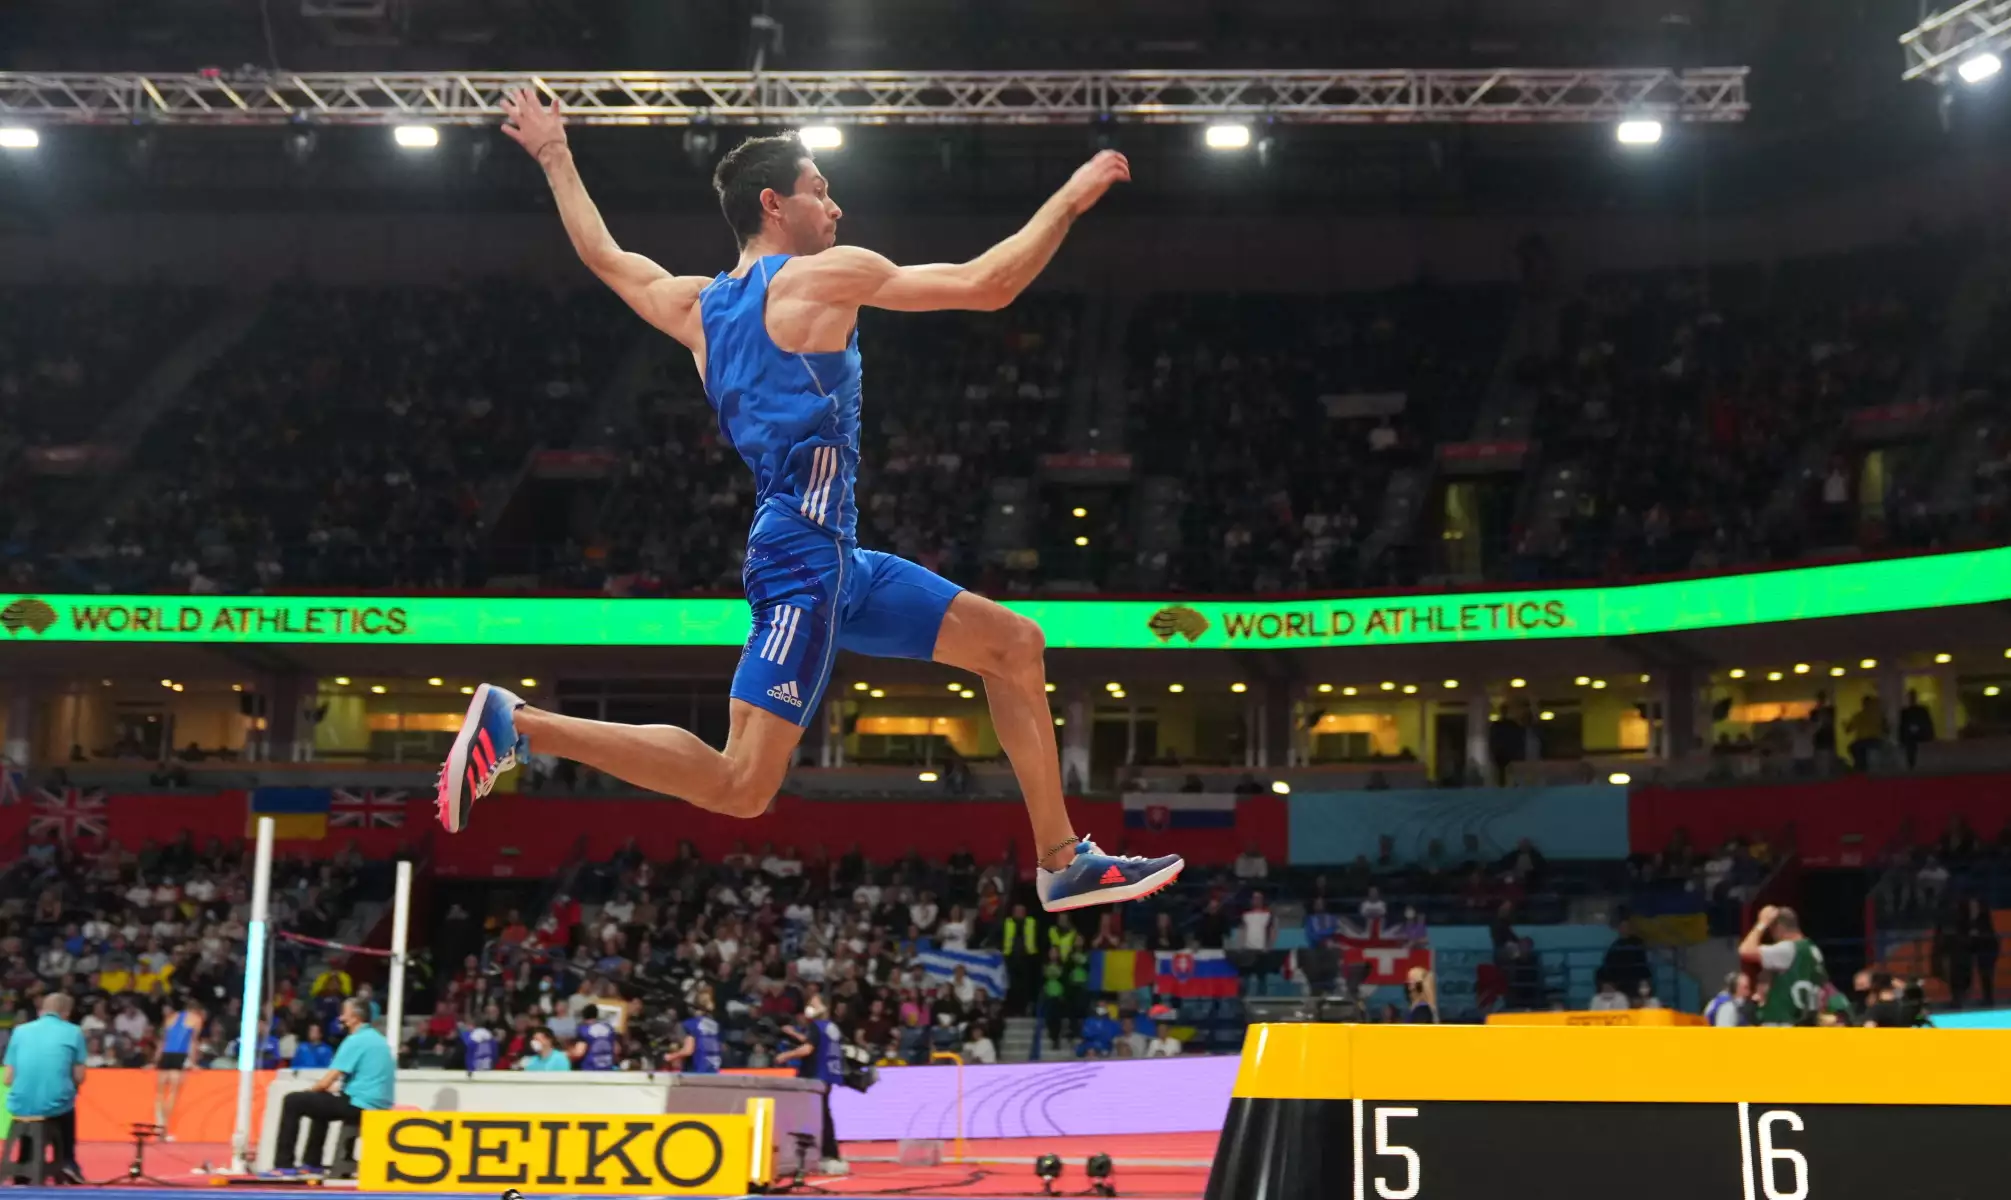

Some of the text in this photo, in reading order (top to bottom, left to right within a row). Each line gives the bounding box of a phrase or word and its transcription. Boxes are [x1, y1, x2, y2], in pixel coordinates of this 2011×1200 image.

[72, 606, 406, 634] WORLD ATHLETICS
[1222, 600, 1565, 639] WORLD ATHLETICS
[766, 689, 802, 708] adidas
[386, 1118, 723, 1187] SEIKO
[1374, 1107, 1420, 1199] 5
[1758, 1110, 1808, 1200] 6
